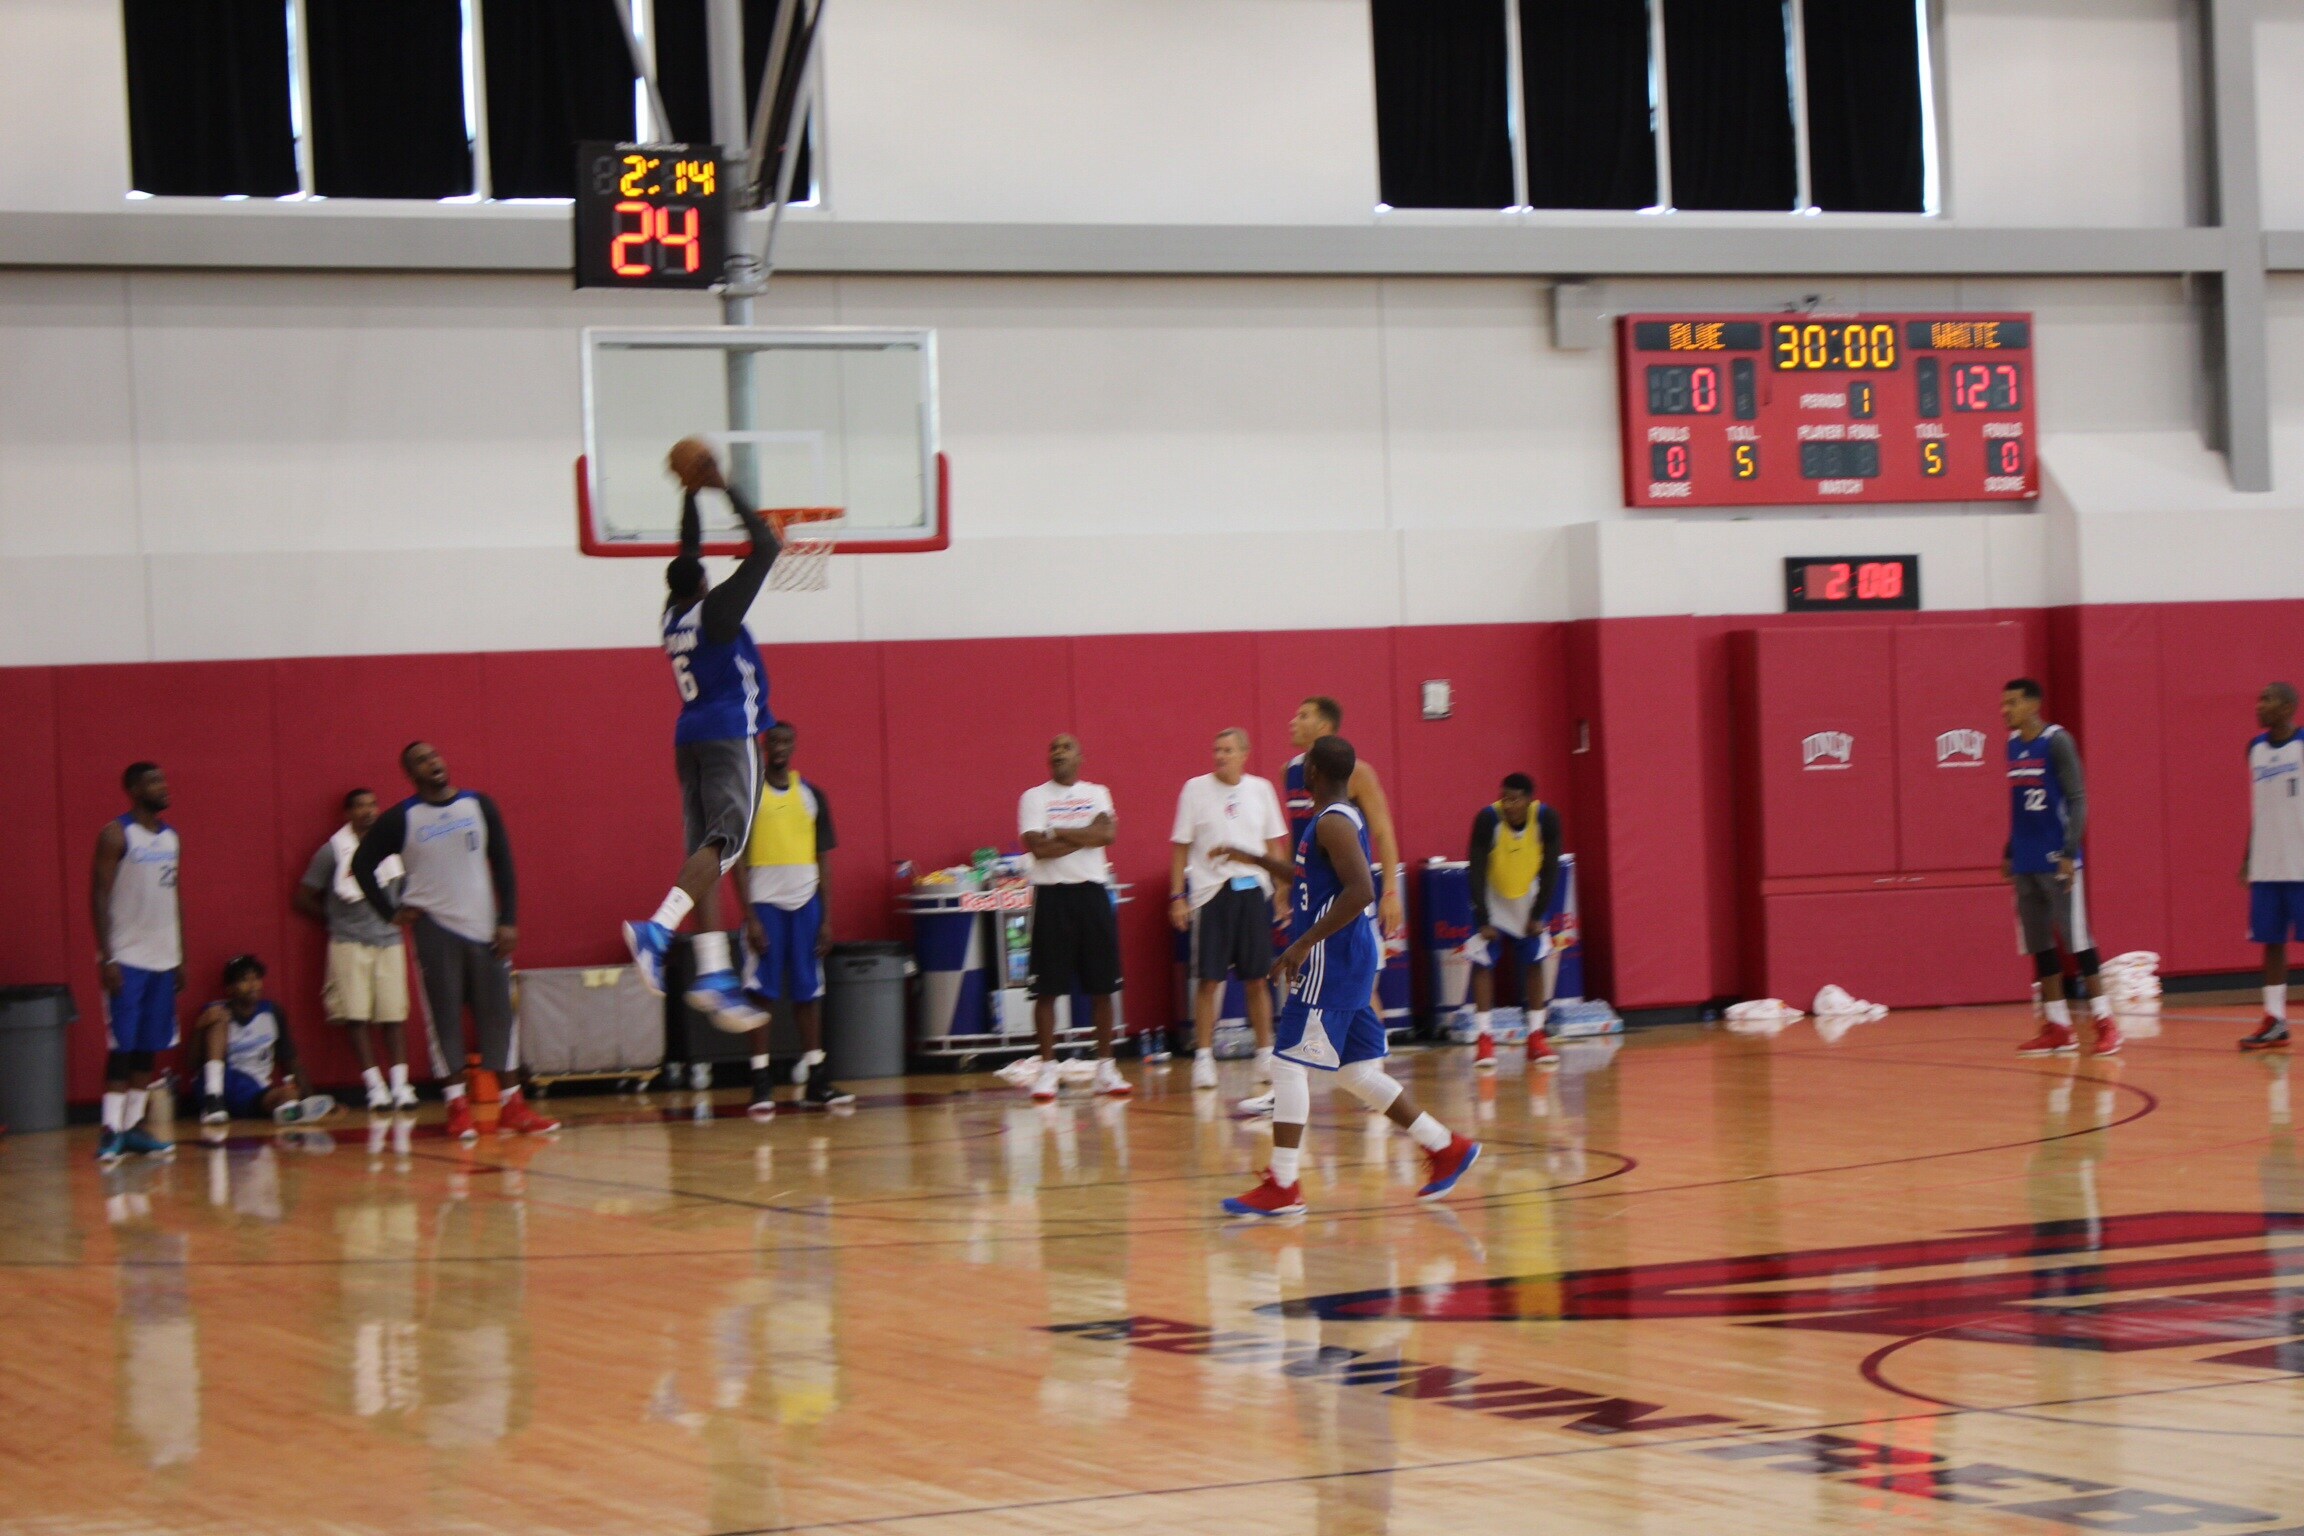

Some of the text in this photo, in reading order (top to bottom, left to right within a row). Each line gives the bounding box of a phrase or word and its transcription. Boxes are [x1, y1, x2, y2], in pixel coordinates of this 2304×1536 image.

[620, 154, 715, 197] 2:14
[611, 201, 699, 276] 24
[1777, 324, 1895, 369] 30:00
[1691, 367, 1717, 412] 0
[1863, 387, 1870, 413] 1
[1956, 365, 2018, 410] 127
[1667, 445, 1687, 478] 0
[1736, 445, 1754, 477] 5
[1924, 442, 1942, 474] 5
[2001, 441, 2019, 473] 0
[671, 654, 699, 702] 6
[1299, 882, 1309, 912] 3
[1686, 1432, 2304, 1536] REB
